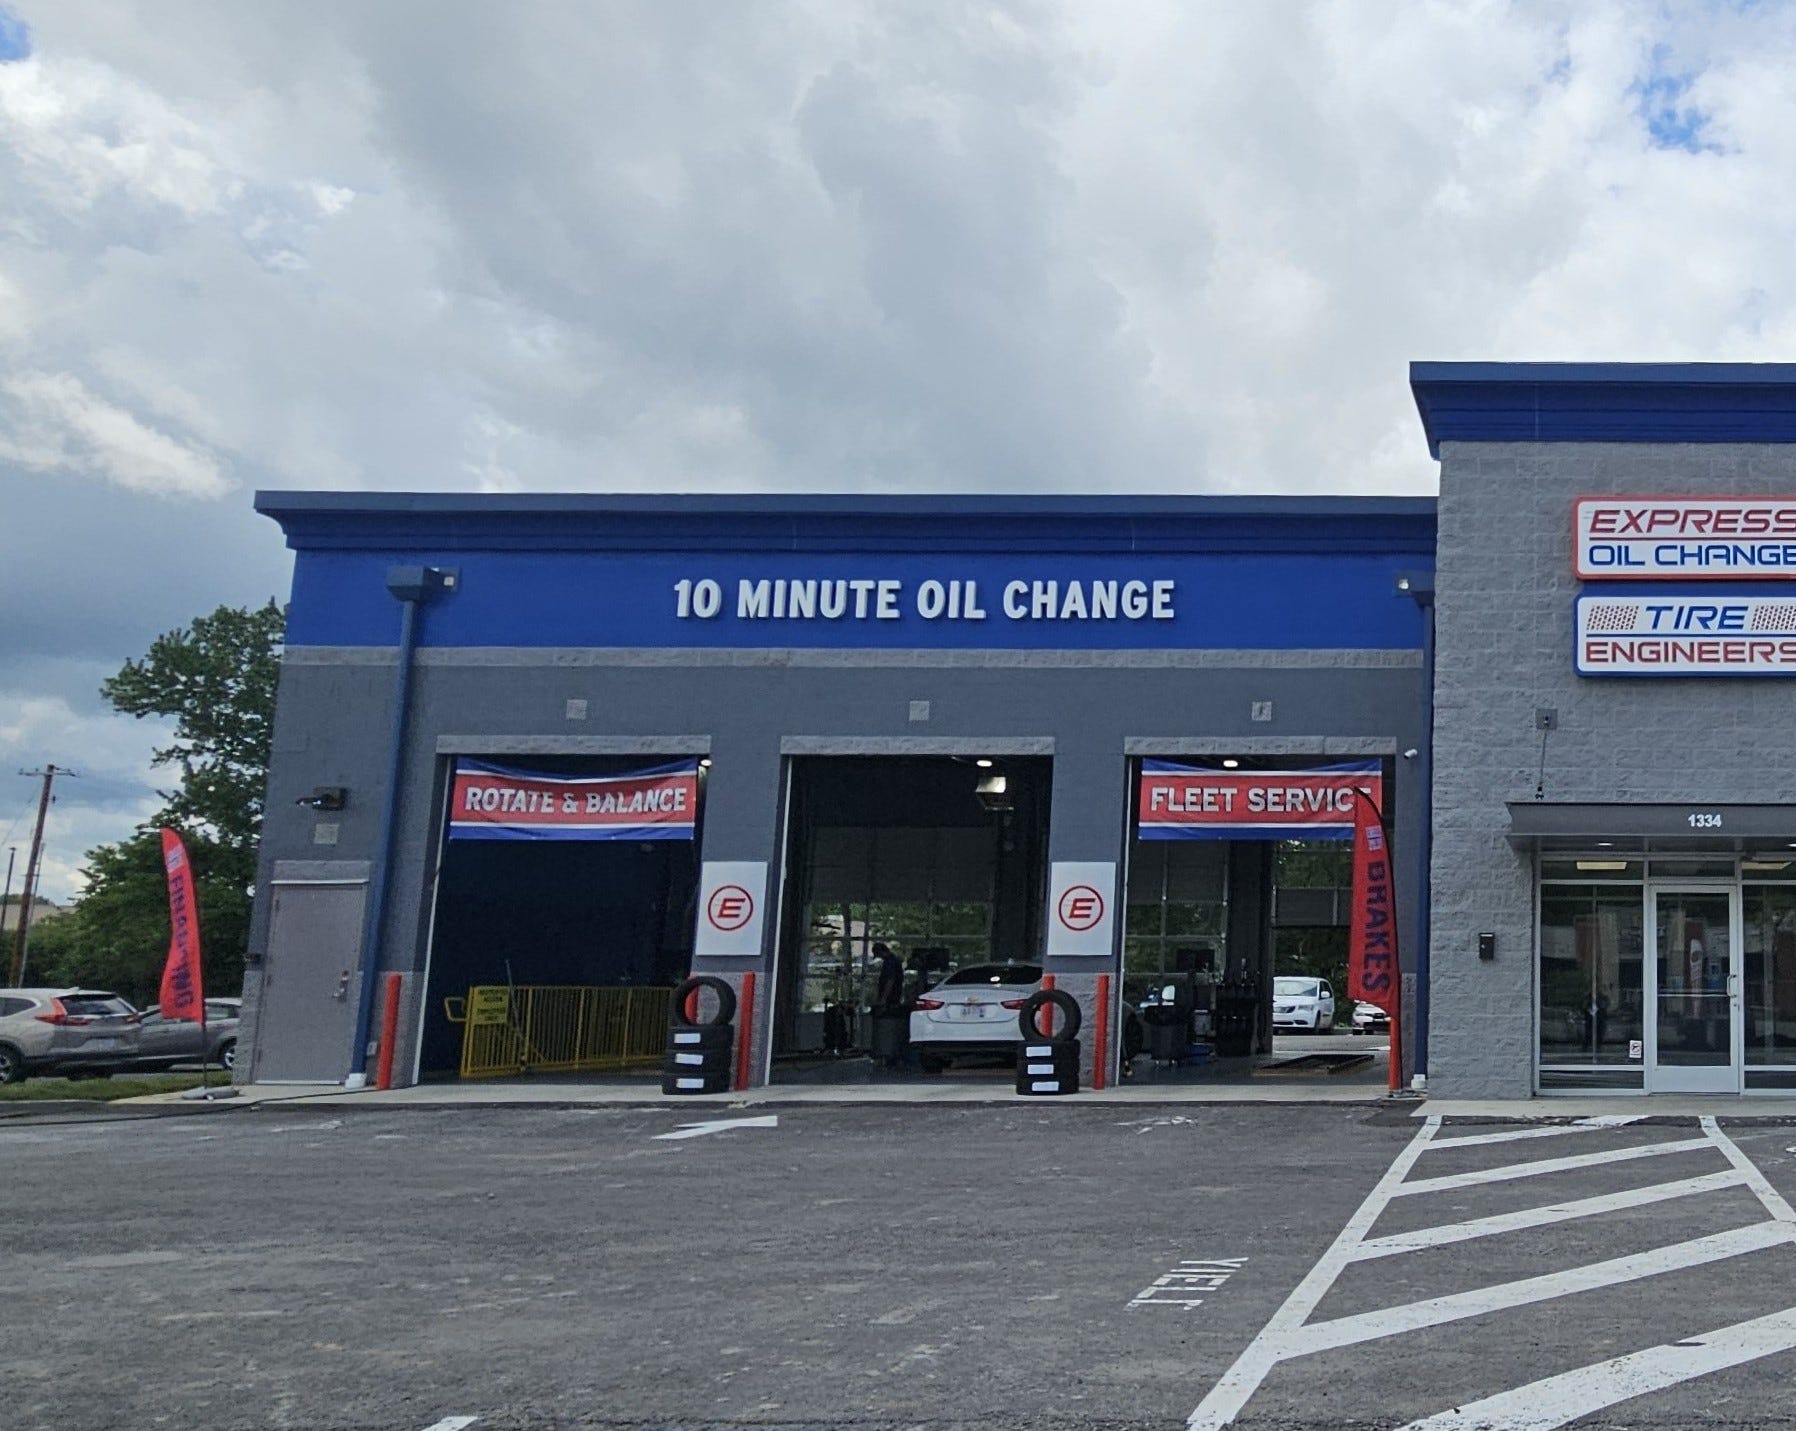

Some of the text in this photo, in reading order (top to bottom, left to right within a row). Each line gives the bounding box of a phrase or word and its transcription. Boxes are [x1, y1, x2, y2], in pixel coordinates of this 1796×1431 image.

[1589, 545, 1645, 566] OIL
[674, 579, 1175, 619] 10 MINUTE OIL CHANGE
[1646, 606, 1749, 630] TIRE
[465, 787, 687, 813] ROTATE & BALANCE
[1151, 787, 1371, 812] FLEET SERVIC
[1687, 813, 1722, 828] 1334
[1362, 861, 1392, 993] BRAKES
